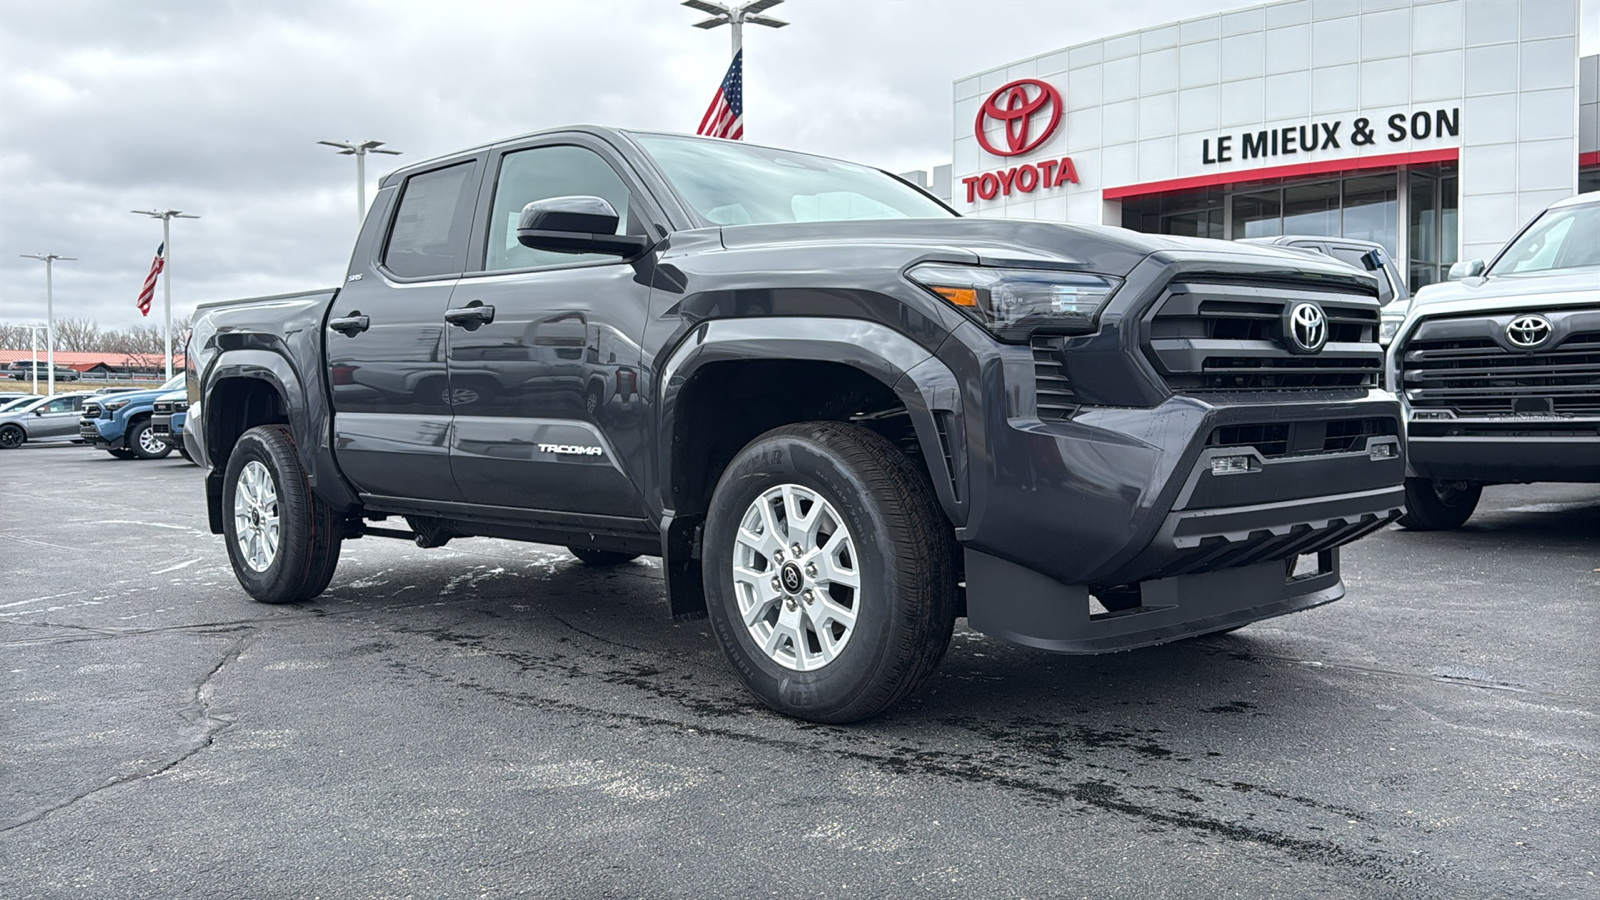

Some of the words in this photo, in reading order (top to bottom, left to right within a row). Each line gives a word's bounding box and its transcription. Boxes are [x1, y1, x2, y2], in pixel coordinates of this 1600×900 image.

[1202, 135, 1232, 165] LE
[1242, 120, 1341, 160] MIEUX
[1350, 117, 1376, 146] &
[1387, 107, 1459, 142] SON
[962, 157, 1079, 203] TOYOTA
[538, 443, 602, 456] TACOMA
[715, 614, 755, 681] TERRITORY
